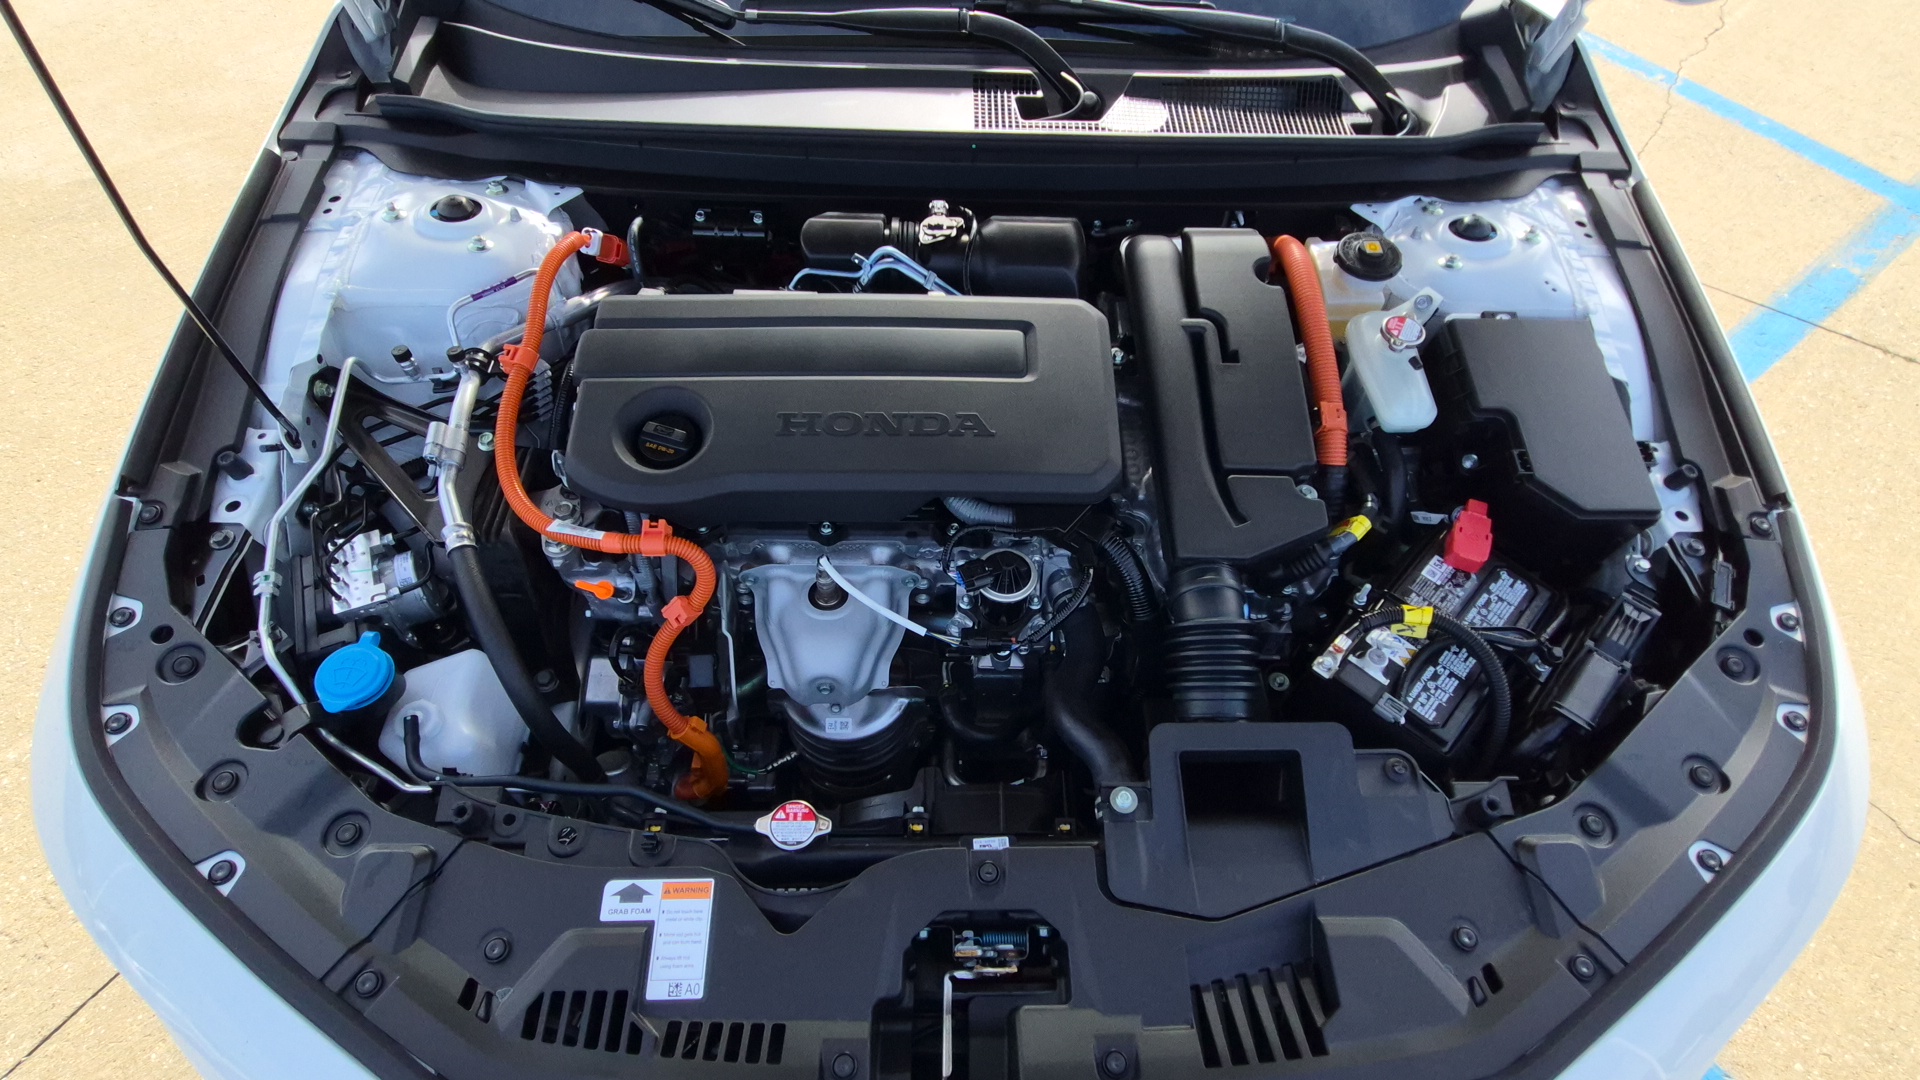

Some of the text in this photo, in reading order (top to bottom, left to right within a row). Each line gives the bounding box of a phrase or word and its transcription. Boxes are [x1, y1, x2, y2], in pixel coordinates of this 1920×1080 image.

[775, 411, 996, 437] HONDA
[645, 442, 657, 450] SAE
[684, 983, 700, 996] A0
